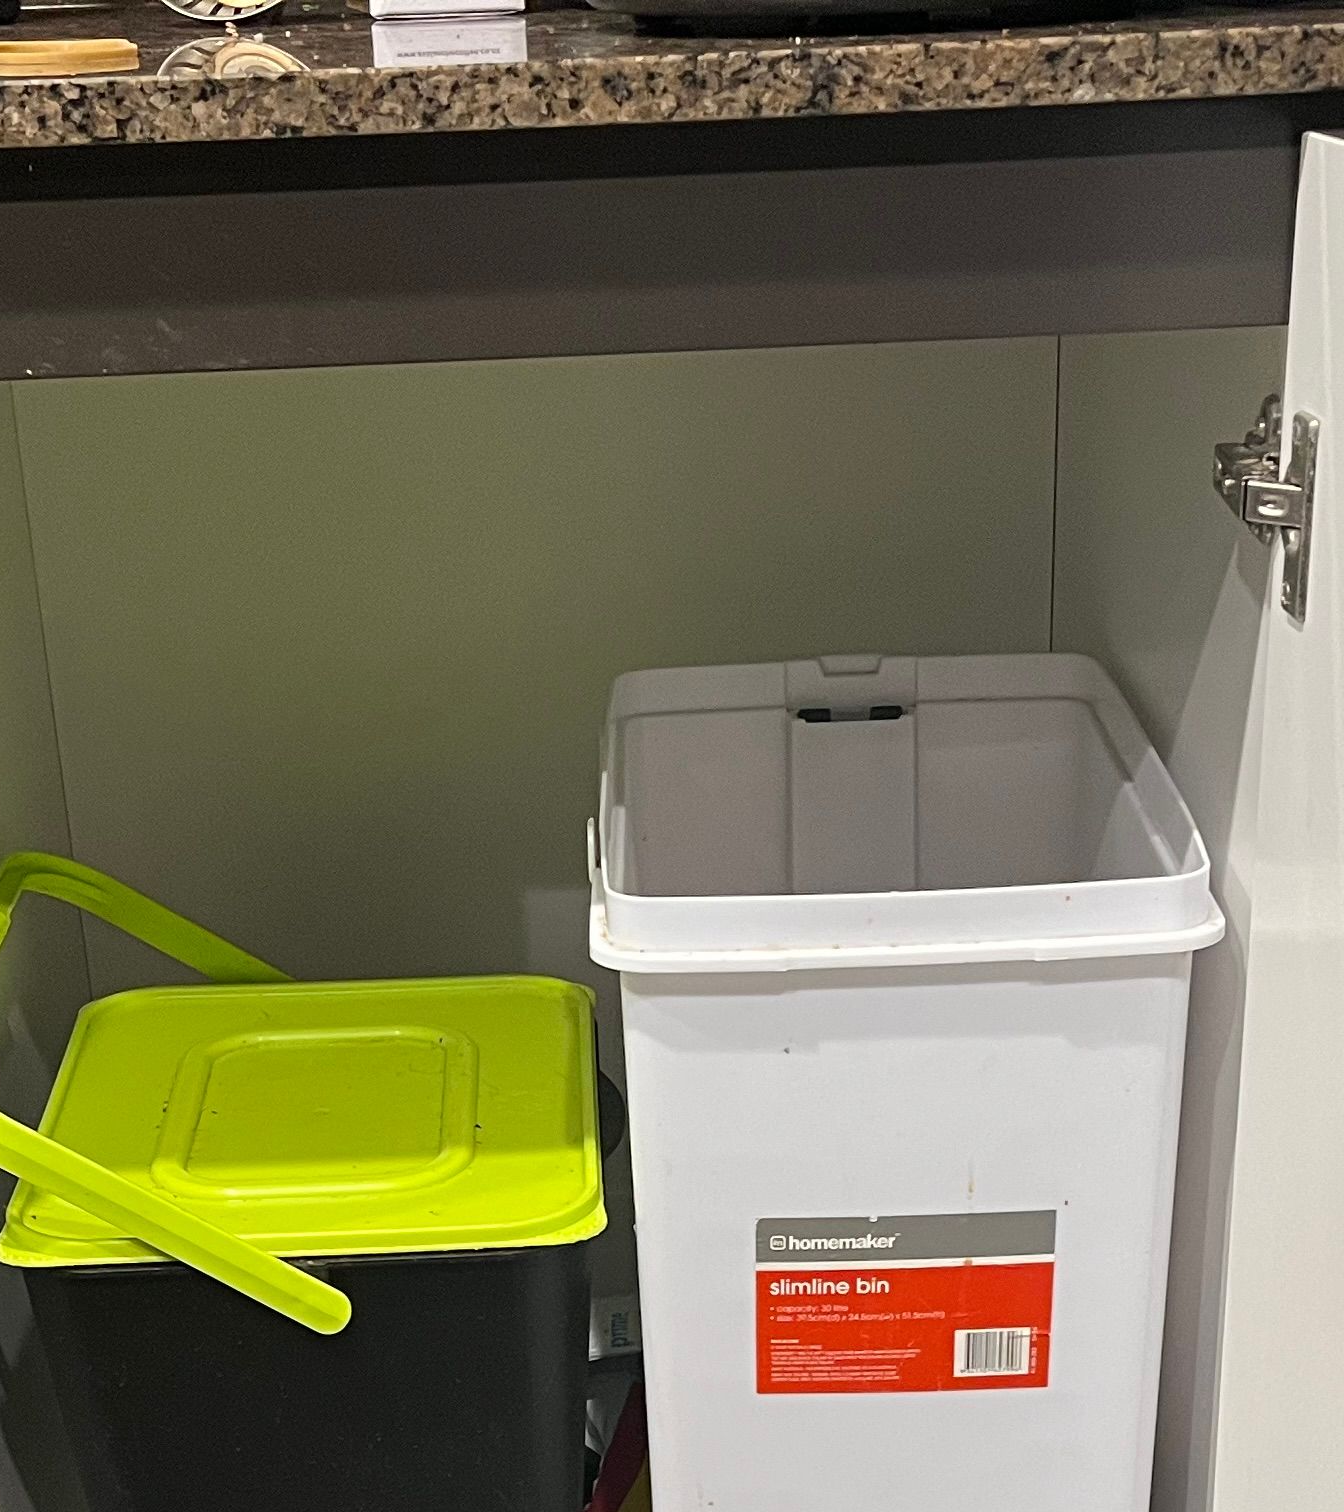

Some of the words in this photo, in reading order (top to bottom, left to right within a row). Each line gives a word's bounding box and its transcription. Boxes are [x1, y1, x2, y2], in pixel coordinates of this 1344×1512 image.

[788, 1233, 896, 1250] homemaker
[770, 1278, 850, 1296] slimline
[856, 1277, 890, 1294] bin
